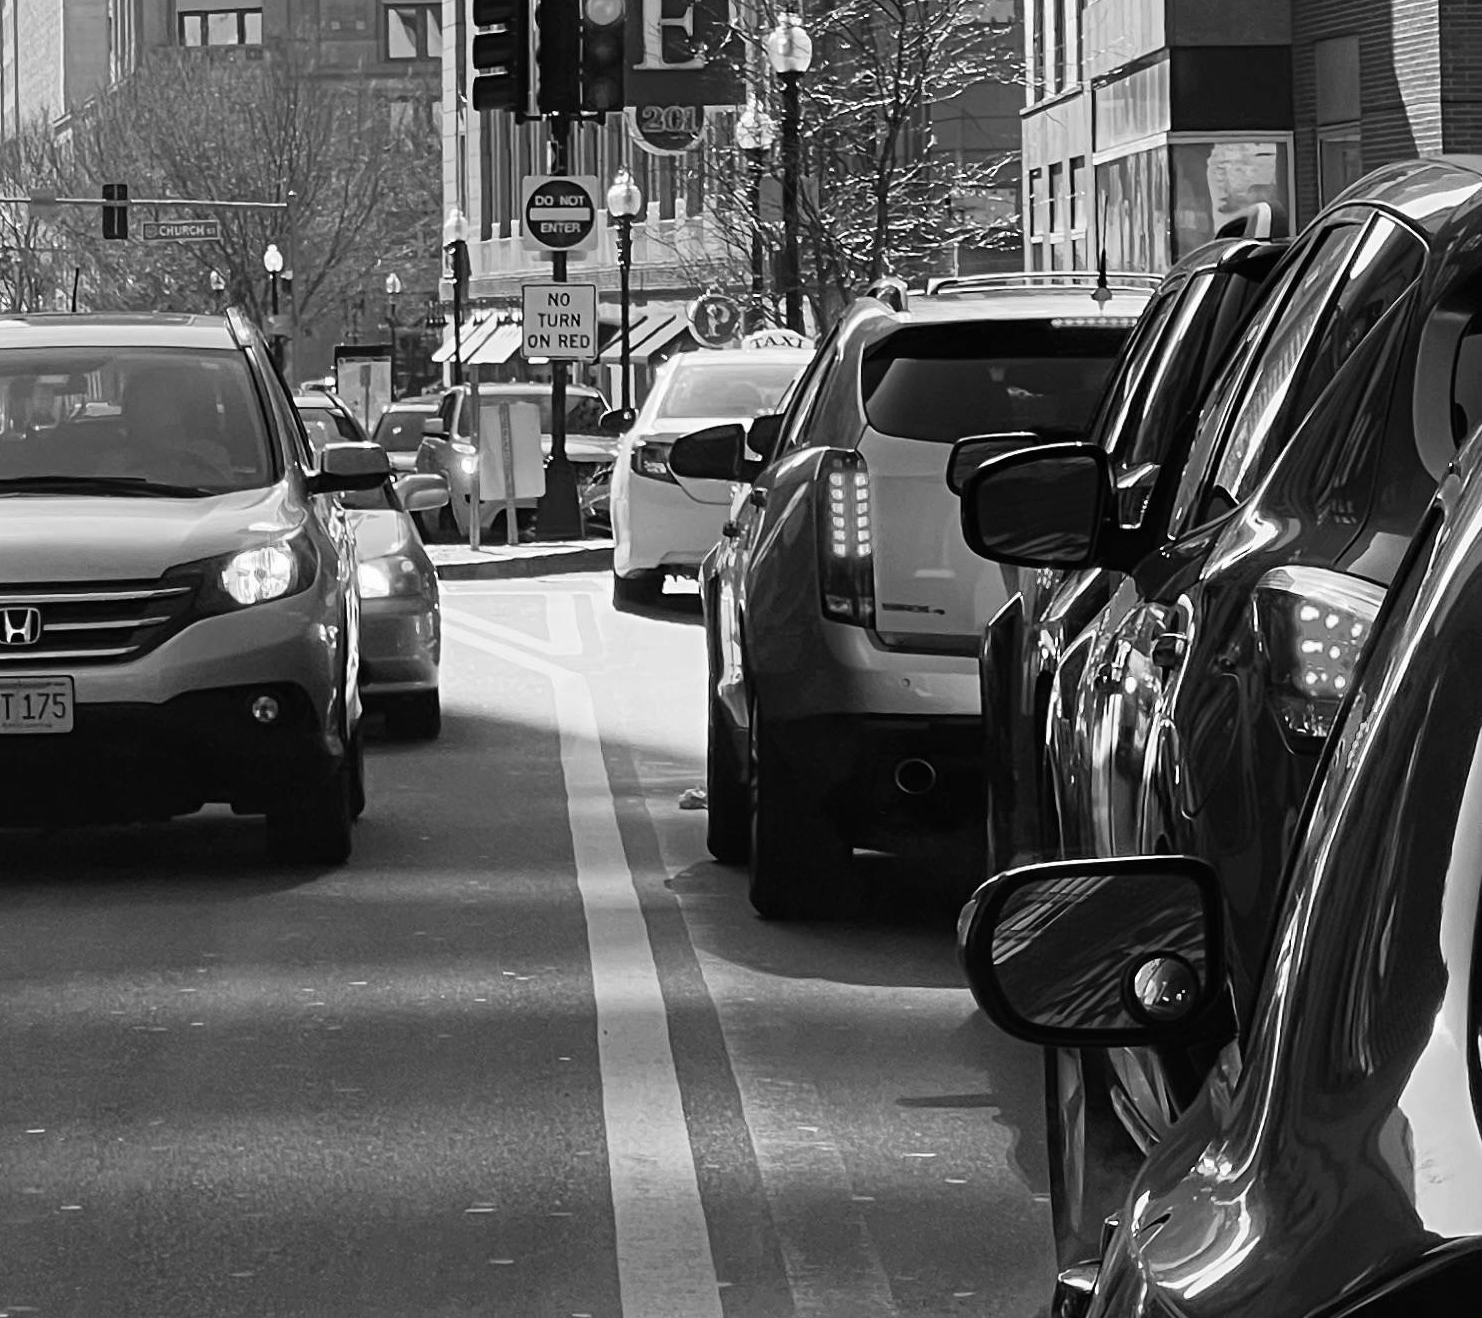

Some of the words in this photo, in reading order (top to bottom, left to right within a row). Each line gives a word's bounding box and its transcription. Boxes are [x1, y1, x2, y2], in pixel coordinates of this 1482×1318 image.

[641, 105, 698, 133] 201
[535, 195, 554, 207] DO
[559, 195, 585, 207] NOT
[159, 225, 205, 237] CHURCH
[540, 222, 581, 234] ENTER
[547, 292, 571, 307] NO
[537, 313, 581, 328] TURN
[527, 334, 551, 349] ON
[558, 334, 591, 349] RED
[750, 335, 804, 349] TAXI
[22, 692, 67, 720] 175
